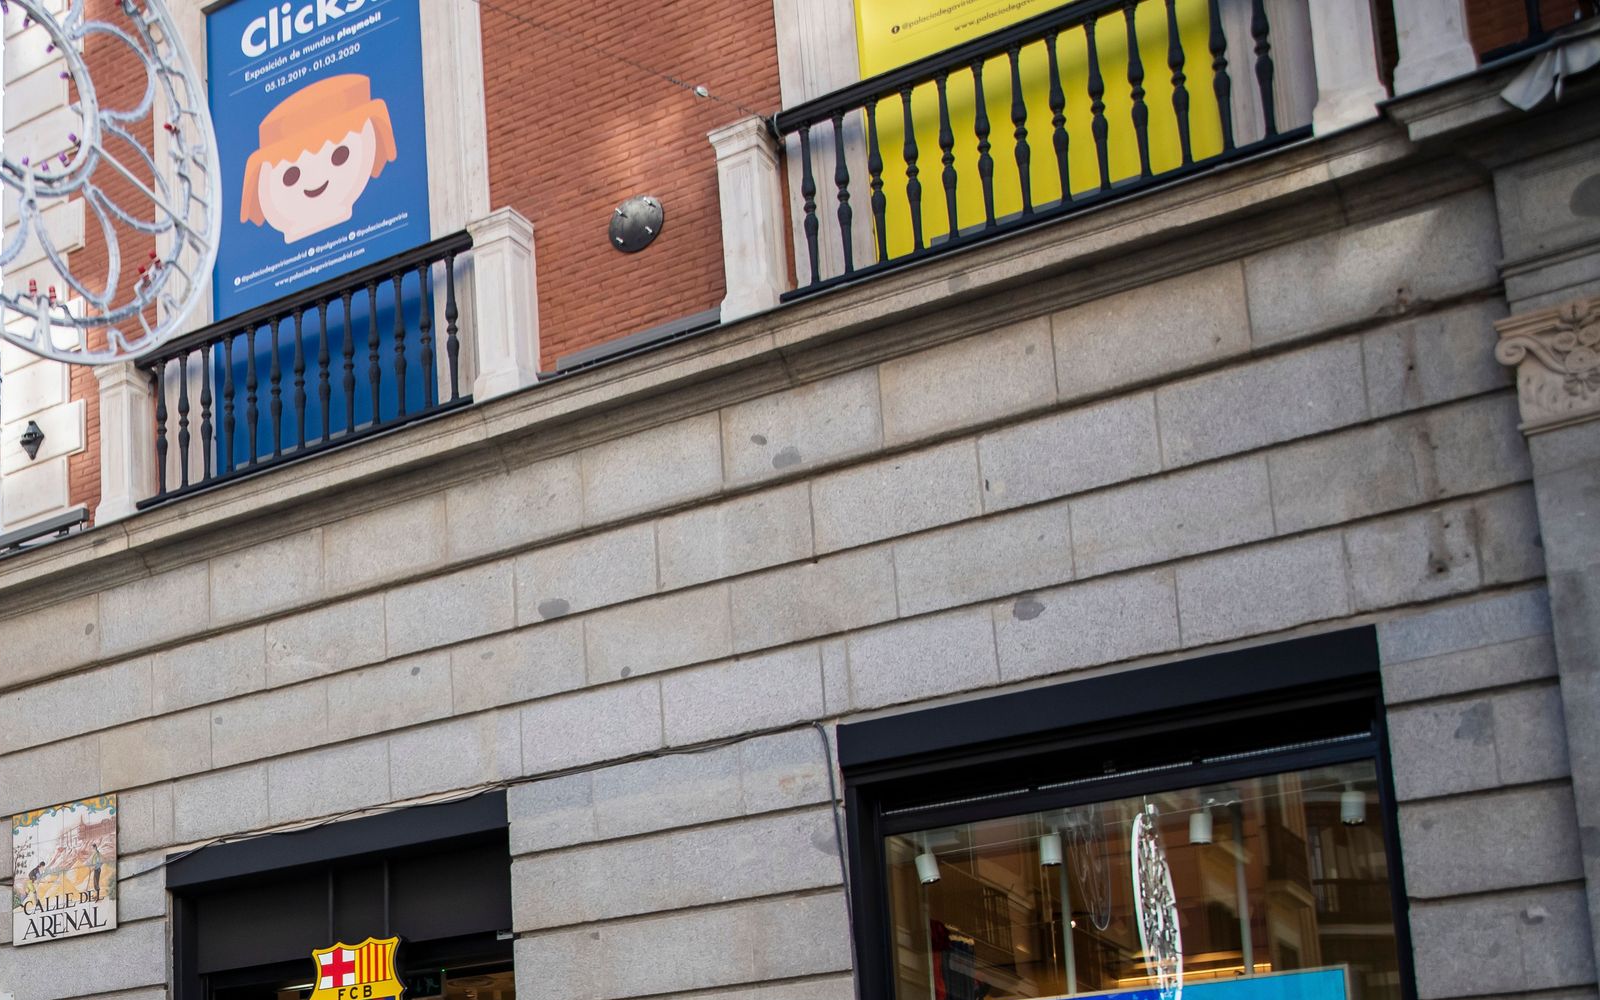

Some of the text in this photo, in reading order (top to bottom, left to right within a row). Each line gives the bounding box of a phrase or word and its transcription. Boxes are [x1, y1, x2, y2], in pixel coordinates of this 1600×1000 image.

[244, 11, 382, 82] Exposición de mundos playmobil
[264, 67, 307, 93] 05.12.2019
[312, 43, 361, 71] 01.03.2020
[22, 888, 105, 916] CALLE DEL
[22, 906, 108, 941] ARENAL
